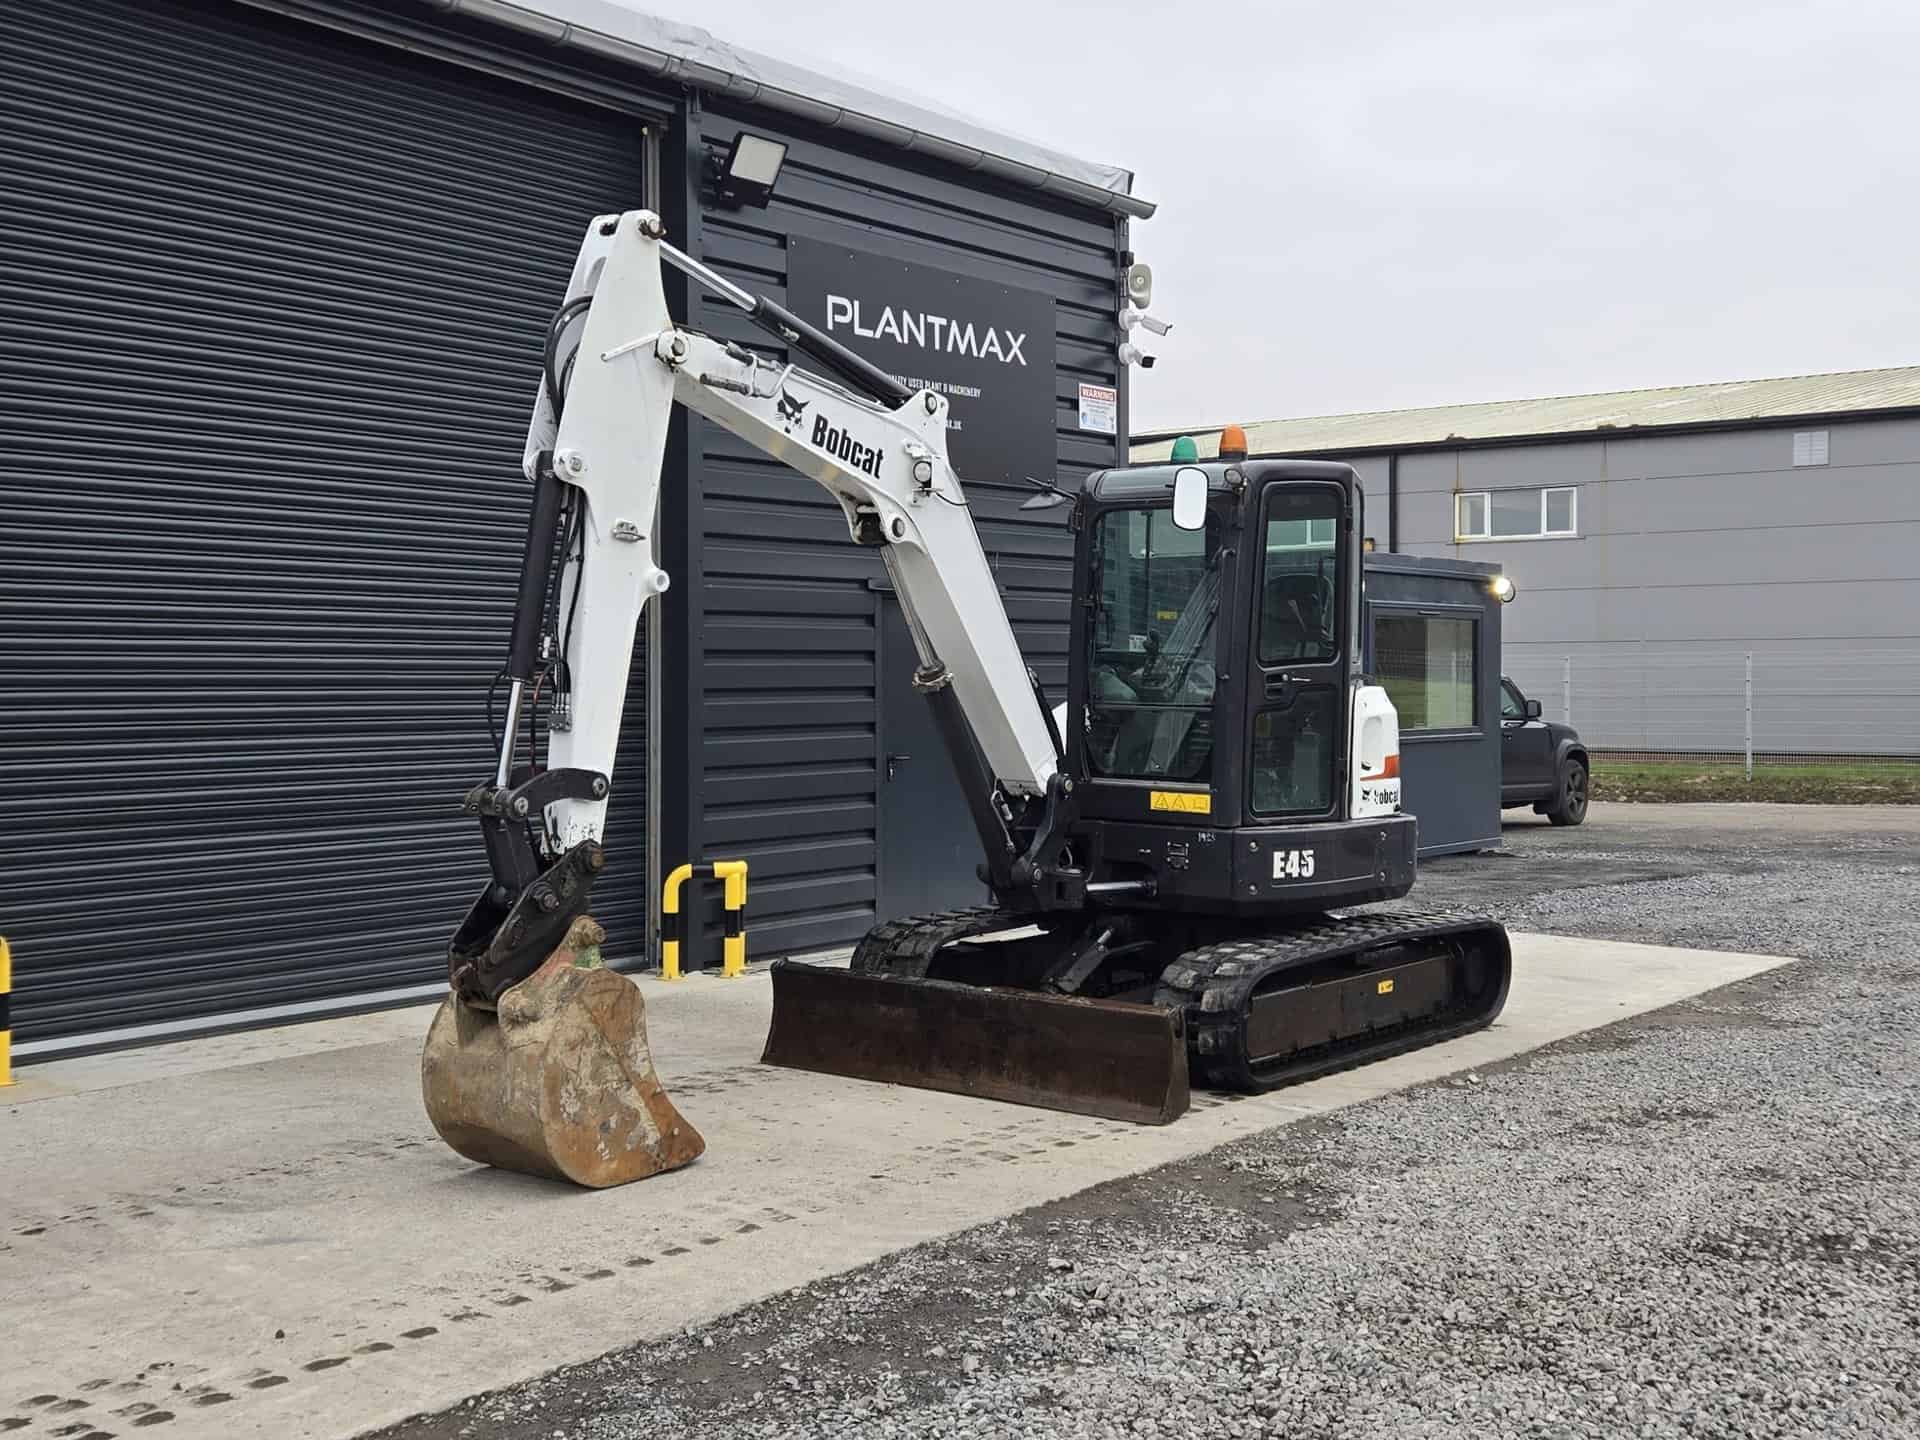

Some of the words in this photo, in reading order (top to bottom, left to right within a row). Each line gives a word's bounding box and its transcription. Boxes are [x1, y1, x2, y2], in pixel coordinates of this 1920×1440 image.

[827, 294, 1027, 366] PLANTMAX
[948, 383, 981, 397] MACHINERY
[1081, 387, 1114, 401] WARNING
[811, 413, 884, 480] Bobcat
[1272, 849, 1315, 879] E45
